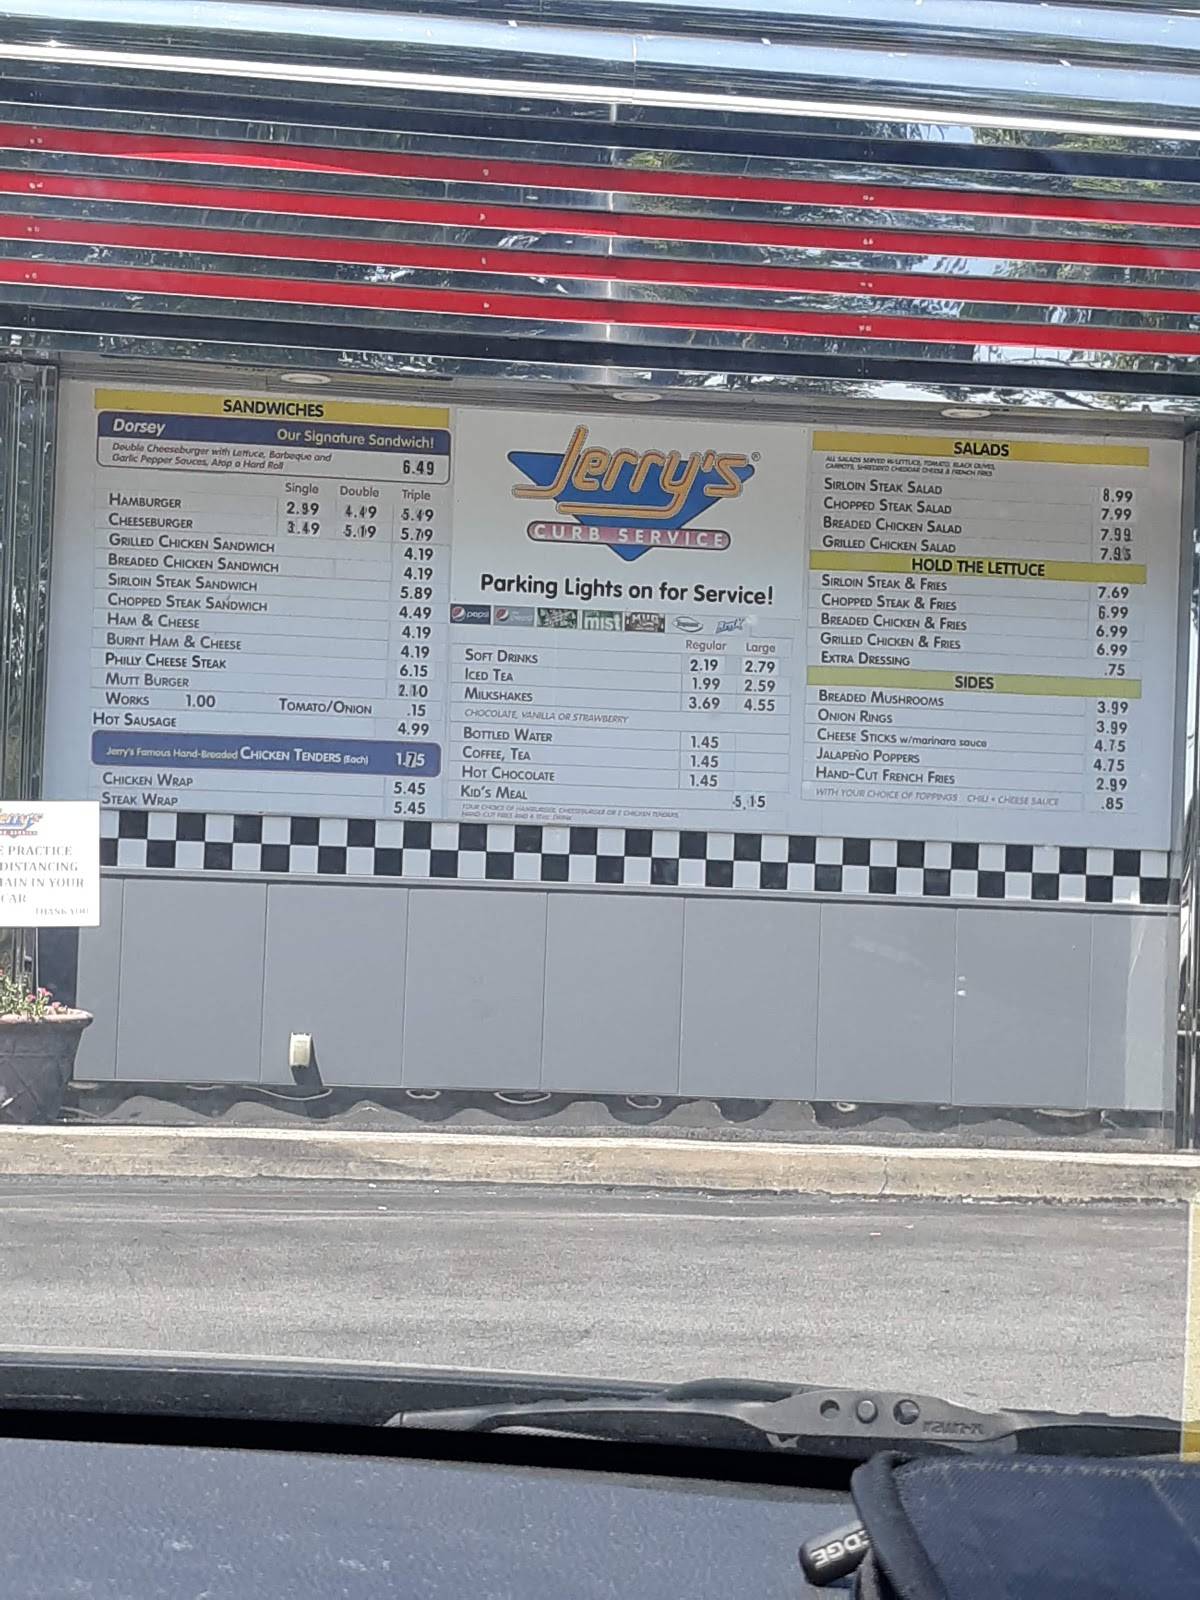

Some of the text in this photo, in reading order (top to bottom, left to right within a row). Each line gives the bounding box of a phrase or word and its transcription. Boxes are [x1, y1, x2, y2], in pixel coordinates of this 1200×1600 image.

[223, 400, 324, 417] SANDWICHES
[113, 418, 166, 436] Dorsey
[277, 429, 434, 448] Our Signature Sandwich!
[112, 442, 144, 451] Double
[147, 444, 209, 455] Cheeseburger
[212, 448, 230, 456] with
[269, 452, 311, 460] Barbeque
[314, 453, 332, 461] and
[954, 442, 1009, 456] SALADS
[112, 454, 138, 462] Garlic
[141, 455, 171, 465] Pepper
[211, 458, 232, 468] Atop
[403, 460, 434, 475] 6.49
[512, 424, 749, 519] Jerry's
[285, 482, 430, 501] Single Double Triple
[824, 477, 1133, 502] SIRLOIN SALAD 8.99
[109, 493, 433, 521] HAMBURGER 4.49 5.49
[824, 497, 1131, 520] CHOPPED SALAD 7.99
[109, 513, 192, 528] CHEESEBURGER
[823, 516, 871, 530] BREADED
[532, 523, 723, 547] CURB SERVICE
[823, 535, 865, 548] GRILLED
[109, 533, 433, 560] GRILLED CHICKEN SANDWICH 4.19
[108, 553, 433, 580] BREADED CHICKEN SANDWICH 4.19
[912, 558, 1045, 576] HOLD THE LETTUCE
[108, 573, 432, 599] SIRLOIN STEAK 5.89
[481, 574, 773, 605] Parking Lights on for Service!
[920, 578, 1129, 598] FRIES 7.69
[108, 593, 432, 619] CHOPPED STEAK 4.49
[466, 611, 489, 619] pepsi
[108, 612, 200, 628] HAM & CHEESE
[583, 613, 621, 630] mist
[1096, 625, 1128, 638] 6.99
[107, 633, 241, 650] BURNT HAM & CHEESE
[686, 640, 775, 654] Regular Large
[105, 652, 428, 677] PHILLY 6.15
[465, 649, 775, 673] SOFT DRINKS 2.19 2.79
[821, 651, 910, 666] EXTRA DRESSING
[106, 672, 189, 687] MUTT BURGER
[465, 668, 775, 692] ICED TEA 1.99 2.59
[955, 675, 994, 689] SIDES
[106, 692, 372, 714] WORKS 1.00 TOMATO/ONION
[465, 687, 775, 711] MILKSHAKES 3.69 4.55
[871, 691, 1128, 715] MUSHROOMS 3.99
[93, 712, 429, 735] HOT SAUSAGE 4.99
[522, 712, 555, 720] VANILLA
[572, 714, 629, 723] STRAWBERRY
[818, 709, 1128, 734] ONION RINGS 3.99
[464, 727, 718, 748] BOTTLED WATER 1.45
[106, 747, 425, 768] Jerry's Famous Hand-Breaded CHICKEN TENDERS (Each) 1.75
[510, 748, 718, 768] TEA 1.45
[873, 750, 1125, 772] POPPERS 4.75
[462, 766, 555, 781] HOT CHOCOLATE
[816, 766, 923, 783] HAND-CUT FRENCH
[157, 774, 426, 795] WRAP 5.45
[461, 785, 528, 800] KID'S MEAL
[142, 793, 426, 815] WRAP 5.45
[816, 788, 838, 797] WITH
[841, 789, 865, 797] YOUR
[867, 790, 899, 799] CHOICE
[915, 792, 957, 801] TOPPINGS
[1031, 798, 1059, 806] SAUCE
[1101, 798, 1123, 810] .85
[8, 846, 72, 856] PRACTICE
[0, 862, 78, 871] DISTANCING
[32, 878, 84, 888] IN YOUR
[35, 907, 67, 915] THANK
